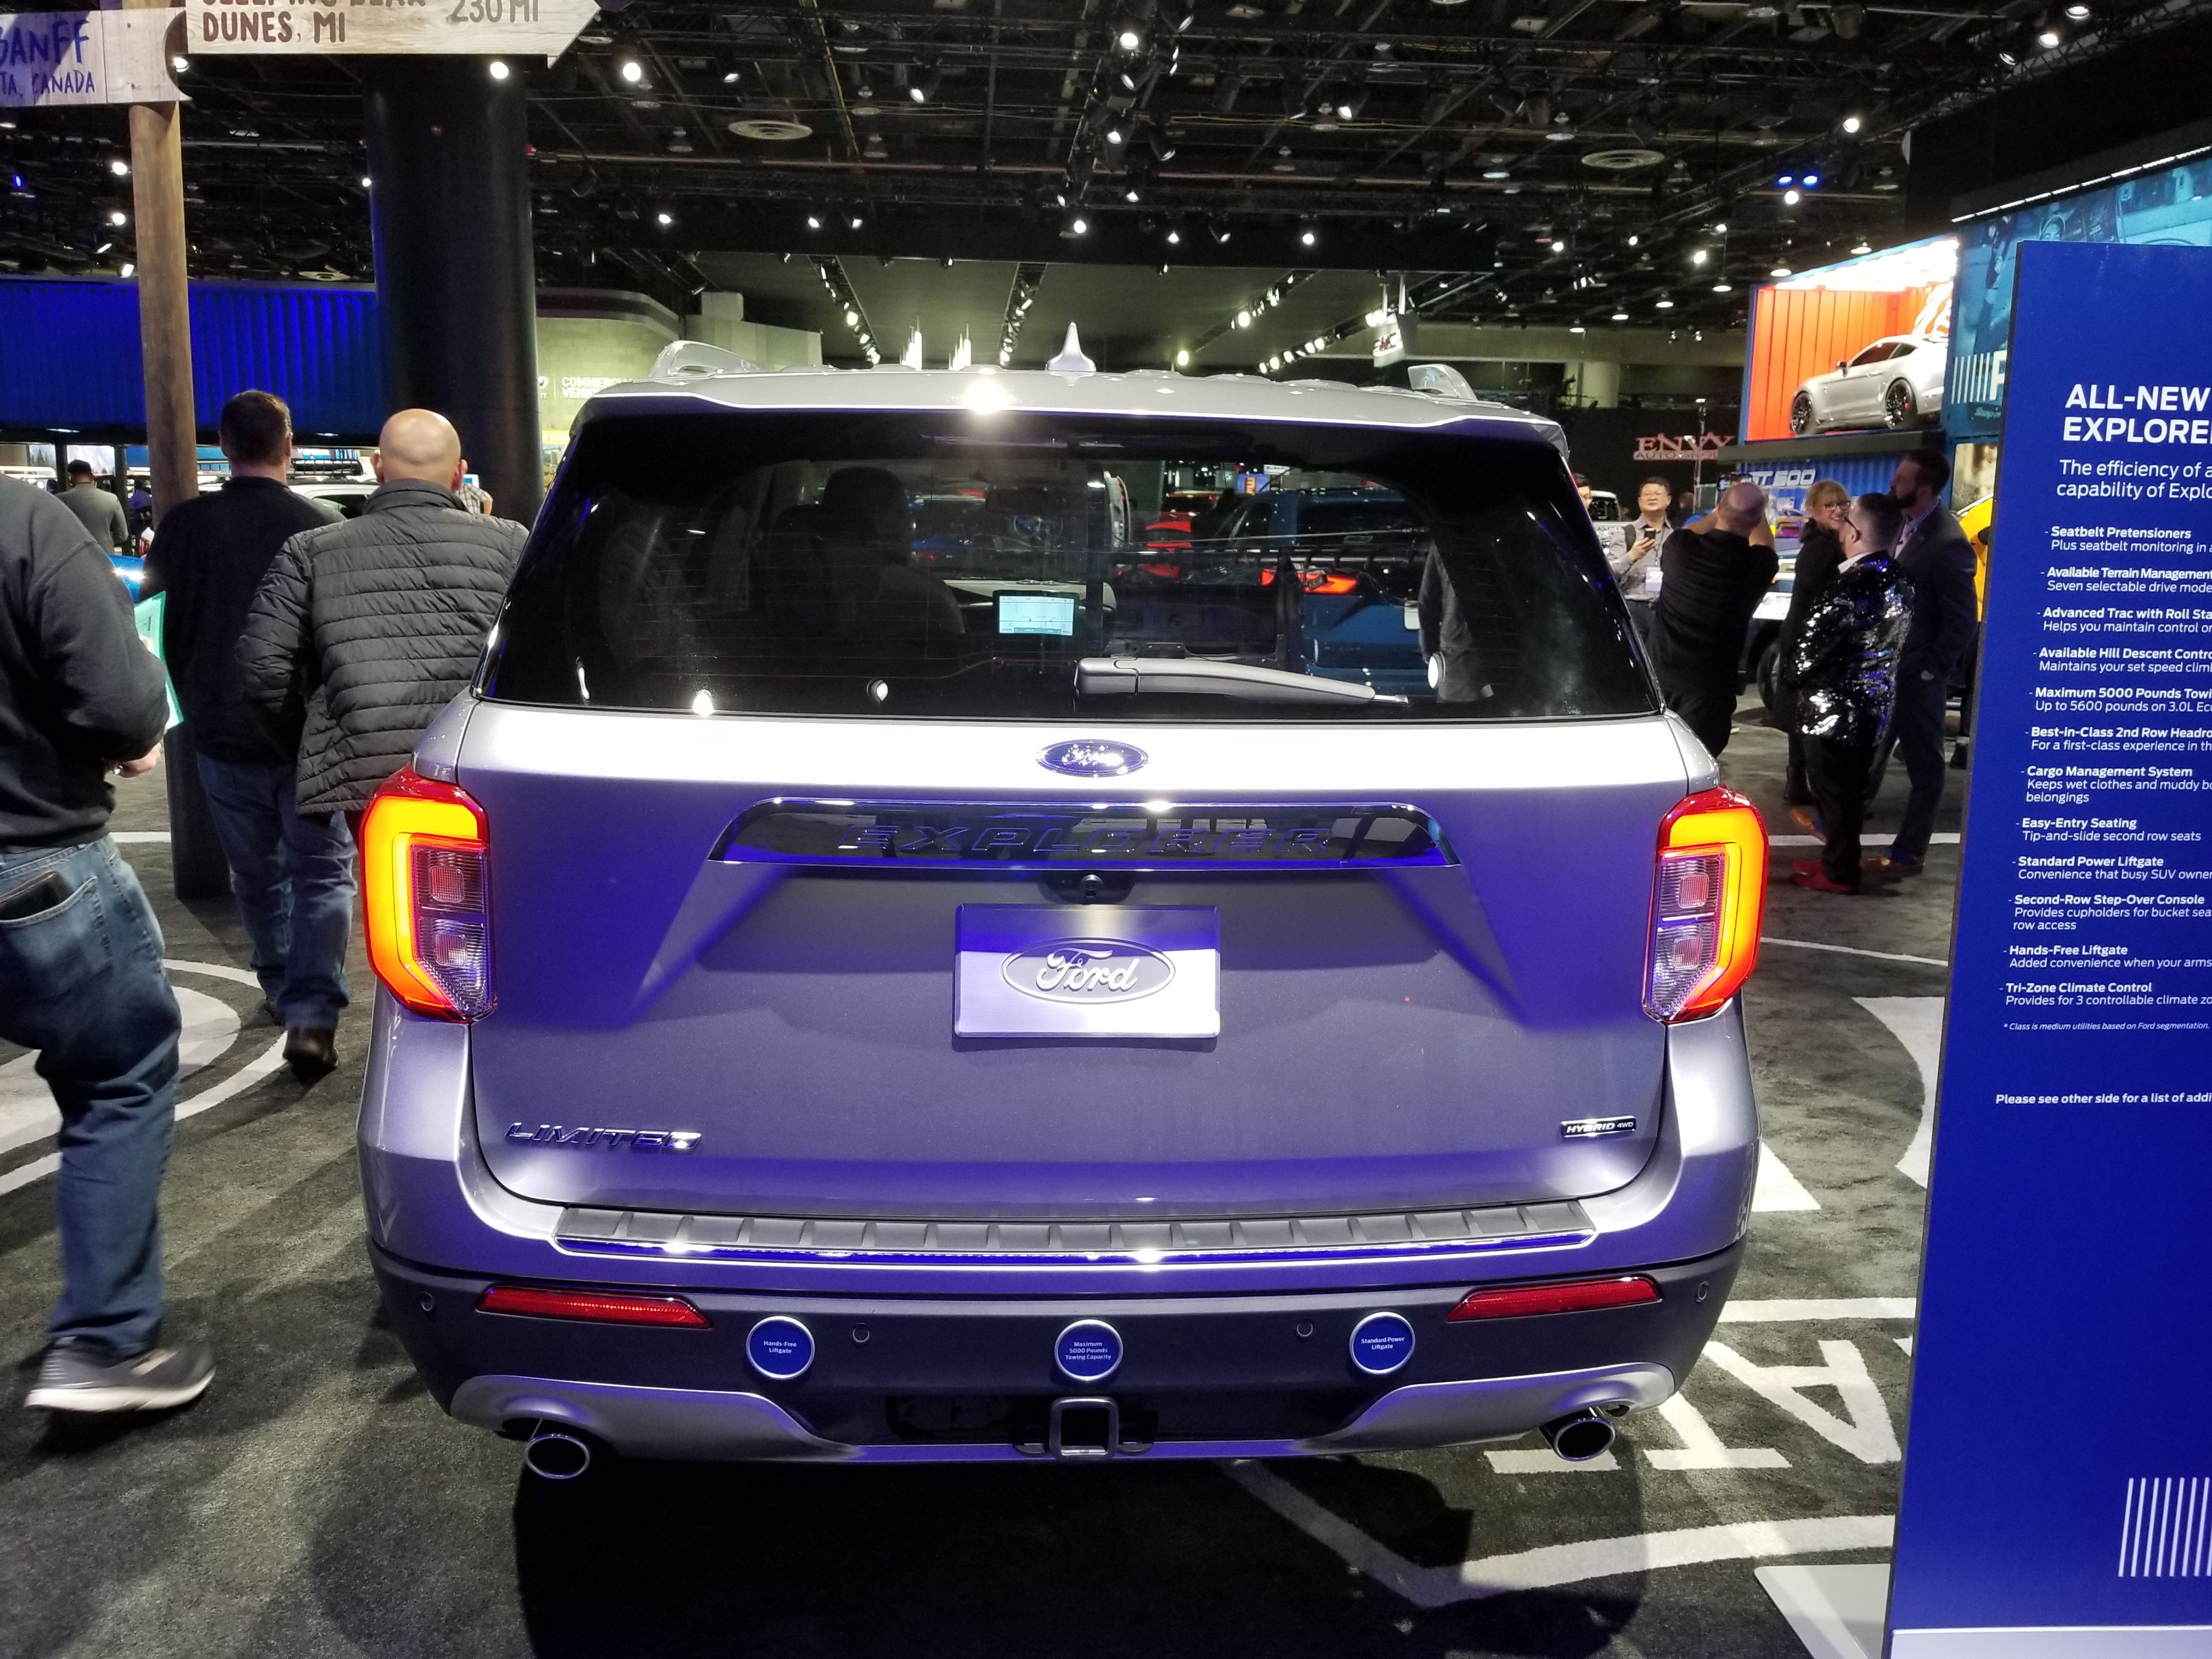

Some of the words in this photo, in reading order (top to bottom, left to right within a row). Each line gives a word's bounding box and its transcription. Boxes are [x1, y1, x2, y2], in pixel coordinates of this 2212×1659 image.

[447, 0, 503, 23] 230
[510, 0, 539, 22] MI
[202, 11, 302, 42] DUNES,
[314, 11, 346, 43] MI
[32, 69, 95, 94] CANADA
[561, 376, 633, 388] COMMERCI
[2064, 383, 2211, 411] ALL-NEW
[2063, 416, 2212, 444] EXPLORE
[2059, 459, 2092, 476] The
[2096, 460, 2180, 480] efficiency
[2183, 461, 2202, 478] of
[1773, 469, 1816, 487] 500
[2057, 481, 2143, 500] capability
[2146, 482, 2166, 498] of
[2051, 526, 2104, 538] Seatbelt
[2107, 527, 2192, 539] Pretensioners
[2051, 539, 2077, 550] Plus
[2079, 540, 2128, 551] seatbelt
[2130, 541, 2194, 555] monitoring
[2196, 542, 2207, 552] in
[2046, 566, 2100, 578] Available
[2100, 567, 2140, 578] Terrain
[2047, 580, 2083, 591] Seven
[2085, 580, 2146, 592] selectable
[2148, 582, 2177, 592] drive
[2042, 607, 2105, 618] Advanced
[2107, 608, 2134, 618] Trac
[2136, 608, 2163, 619] with
[2165, 608, 2190, 619] Roll
[2043, 620, 2077, 633] Helps
[2080, 623, 2101, 633] you
[2103, 621, 2155, 632] maintain
[2158, 622, 2198, 633] control
[2039, 647, 2097, 658] Available
[2099, 647, 2120, 658] Hill
[2123, 648, 2172, 659] Descent
[2039, 661, 2097, 672] Maintains
[2099, 663, 2125, 674] your
[2127, 662, 2146, 672] set
[2147, 662, 2183, 674] speed
[2035, 687, 2096, 698] Maximum
[2098, 687, 2133, 698] 5000
[2135, 688, 2182, 699] Pounds
[2035, 700, 2052, 713] Up
[2055, 701, 2067, 711] to
[2069, 700, 2103, 711] 5600
[2105, 701, 2149, 713] pounds
[2151, 703, 2166, 712] on
[2168, 702, 2194, 712] 3.0L
[2031, 726, 2114, 738] Best-in-Class
[2115, 727, 2139, 738] 2nd
[2141, 727, 2169, 738] Row
[2031, 740, 2051, 750] For
[2053, 742, 2060, 750] a
[2063, 740, 2120, 751] first-class
[2123, 740, 2185, 752] experience
[2187, 741, 2198, 751] in
[2027, 765, 2063, 777] Cargo
[2066, 766, 2146, 778] Management
[2147, 766, 2193, 778] System
[2027, 778, 2063, 791] Keeps
[2066, 780, 2088, 789] wet
[2090, 778, 2132, 789] clothes
[2135, 779, 2158, 789] and
[2159, 779, 2200, 792] muddy
[2026, 792, 2090, 804] belongings
[2022, 817, 2089, 830] Easy-Entry
[2090, 817, 2137, 830] Seating
[838, 825, 1333, 854] EXPLORER
[2022, 831, 2101, 843] Tip-and-slide
[2103, 831, 2145, 841] second
[2147, 833, 2169, 841] row
[2170, 831, 2201, 841] seats
[2018, 856, 2075, 866] Standard
[2077, 856, 2116, 866] Power
[2118, 856, 2164, 868] Liftgate
[2018, 869, 2092, 879] Convenience
[2095, 869, 2119, 879] that
[2121, 869, 2148, 881] busy
[2151, 869, 2176, 879] SUV
[2014, 894, 2092, 905] Second-Row
[2093, 894, 2155, 906] Step-Over
[2157, 894, 2205, 905] Console
[2015, 907, 2064, 917] Provides
[2067, 907, 2130, 919] cupholders
[2133, 907, 2149, 917] for
[2151, 907, 2190, 917] bucket
[2013, 922, 2035, 930] row
[2037, 922, 2076, 930] access
[2009, 945, 2080, 955] Hands-Free
[2081, 945, 2128, 957] Liftgate
[1036, 947, 1140, 991] Ford
[2009, 957, 2047, 968] Added
[2050, 958, 2121, 968] convenience
[2124, 957, 2154, 967] when
[2157, 960, 2182, 969] your
[2006, 983, 2057, 993] Tri-Zone
[2058, 982, 2106, 993] Climate
[2108, 982, 2152, 992] Control
[2006, 995, 2055, 1006] Provides
[2057, 995, 2074, 1005] for
[2076, 995, 2083, 1005] 3
[2086, 995, 2154, 1005] controllable
[2156, 994, 2198, 1005] climate
[1996, 1094, 2036, 1104] Please
[2038, 1096, 2059, 1104] see
[2061, 1093, 2094, 1104] other
[2095, 1093, 2120, 1103] side
[2121, 1093, 2140, 1103] for
[2151, 1093, 2170, 1103] list
[2171, 1092, 2185, 1103] of
[1566, 1122, 1615, 1133] HYBRID
[504, 1122, 702, 1148] LIMITED
